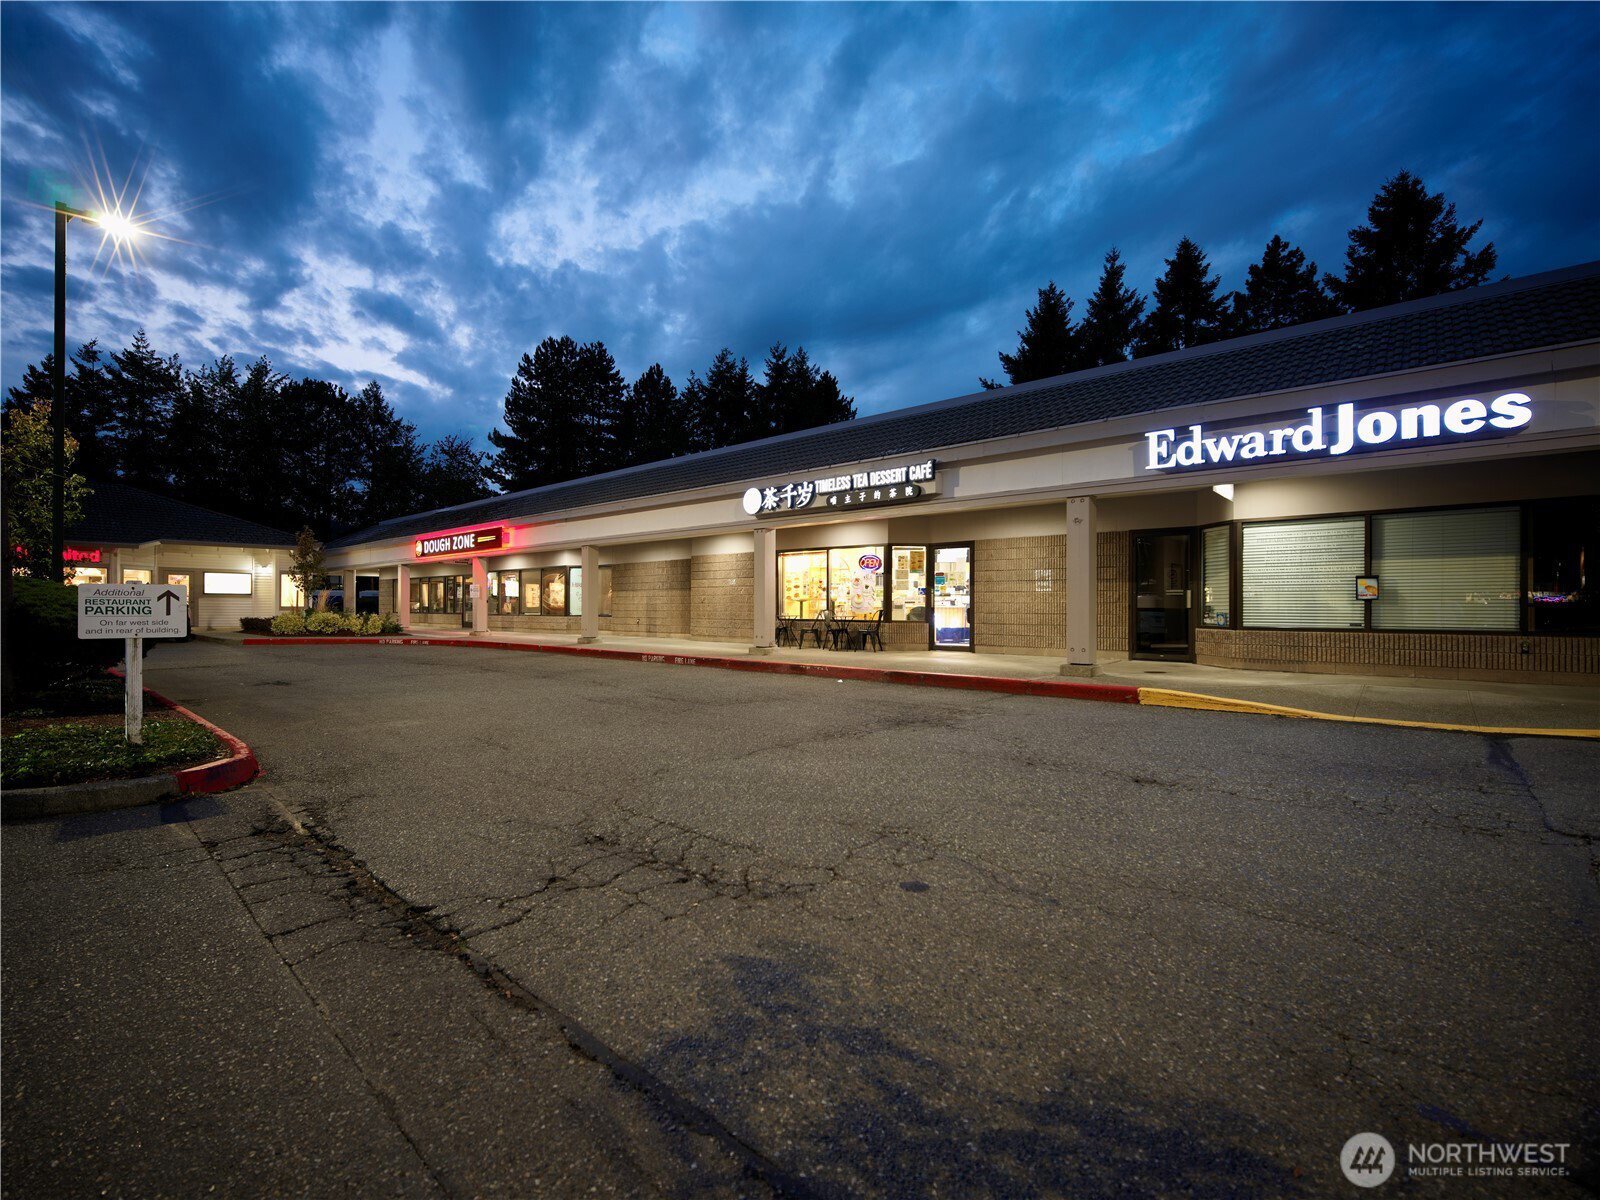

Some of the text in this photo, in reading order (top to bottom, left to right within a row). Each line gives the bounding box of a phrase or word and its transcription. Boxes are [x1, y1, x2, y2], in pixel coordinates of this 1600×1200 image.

[814, 459, 933, 494] TIMELESS TEA DESSERT CAFÉ
[762, 481, 814, 510] 茶千岁
[423, 533, 475, 554] DOUGH ZONE
[860, 557, 879, 569] OPEN
[93, 588, 145, 597] Additional
[84, 606, 152, 615] PARKING
[99, 619, 113, 627] On
